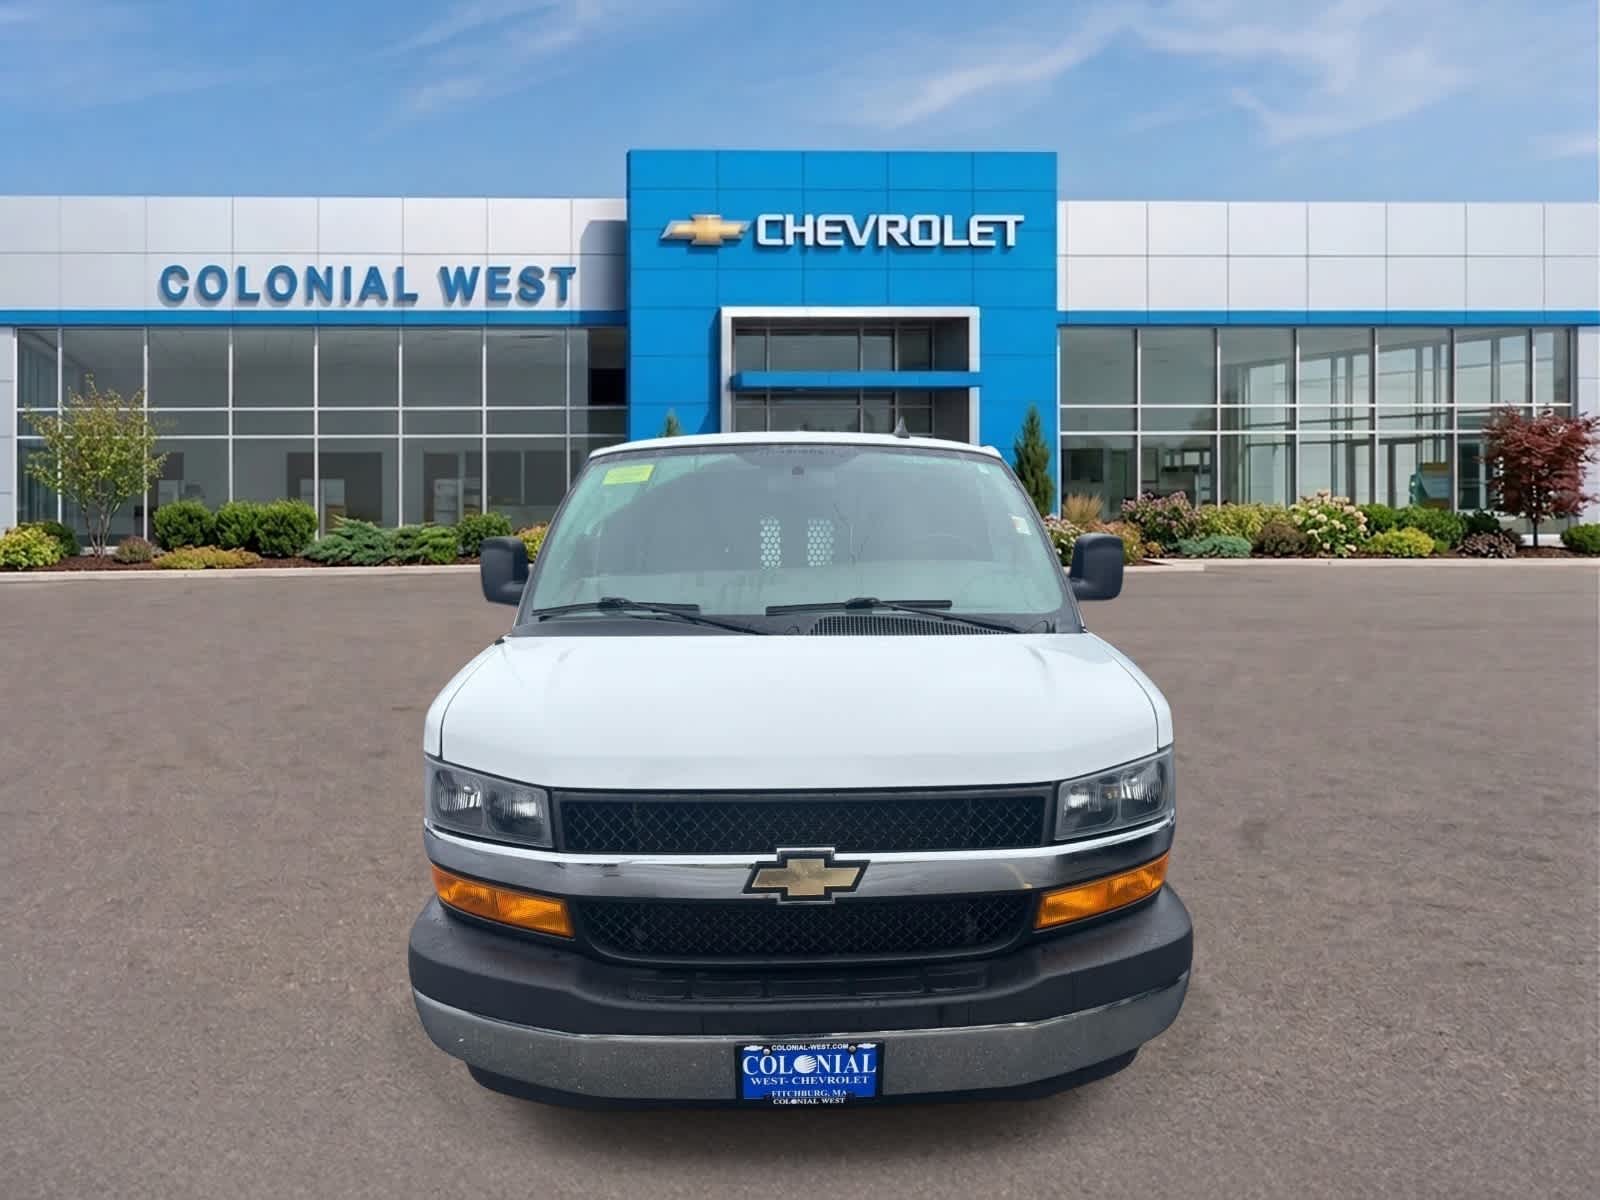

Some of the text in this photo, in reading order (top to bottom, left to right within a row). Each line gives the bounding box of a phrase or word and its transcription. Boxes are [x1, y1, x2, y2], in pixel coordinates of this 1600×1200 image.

[757, 214, 1024, 247] CHEVROLET
[159, 265, 577, 305] COLONIAL WEST
[771, 1043, 849, 1051] COLONIAL-WEST.COM
[792, 1076, 869, 1086] CHEVROLET
